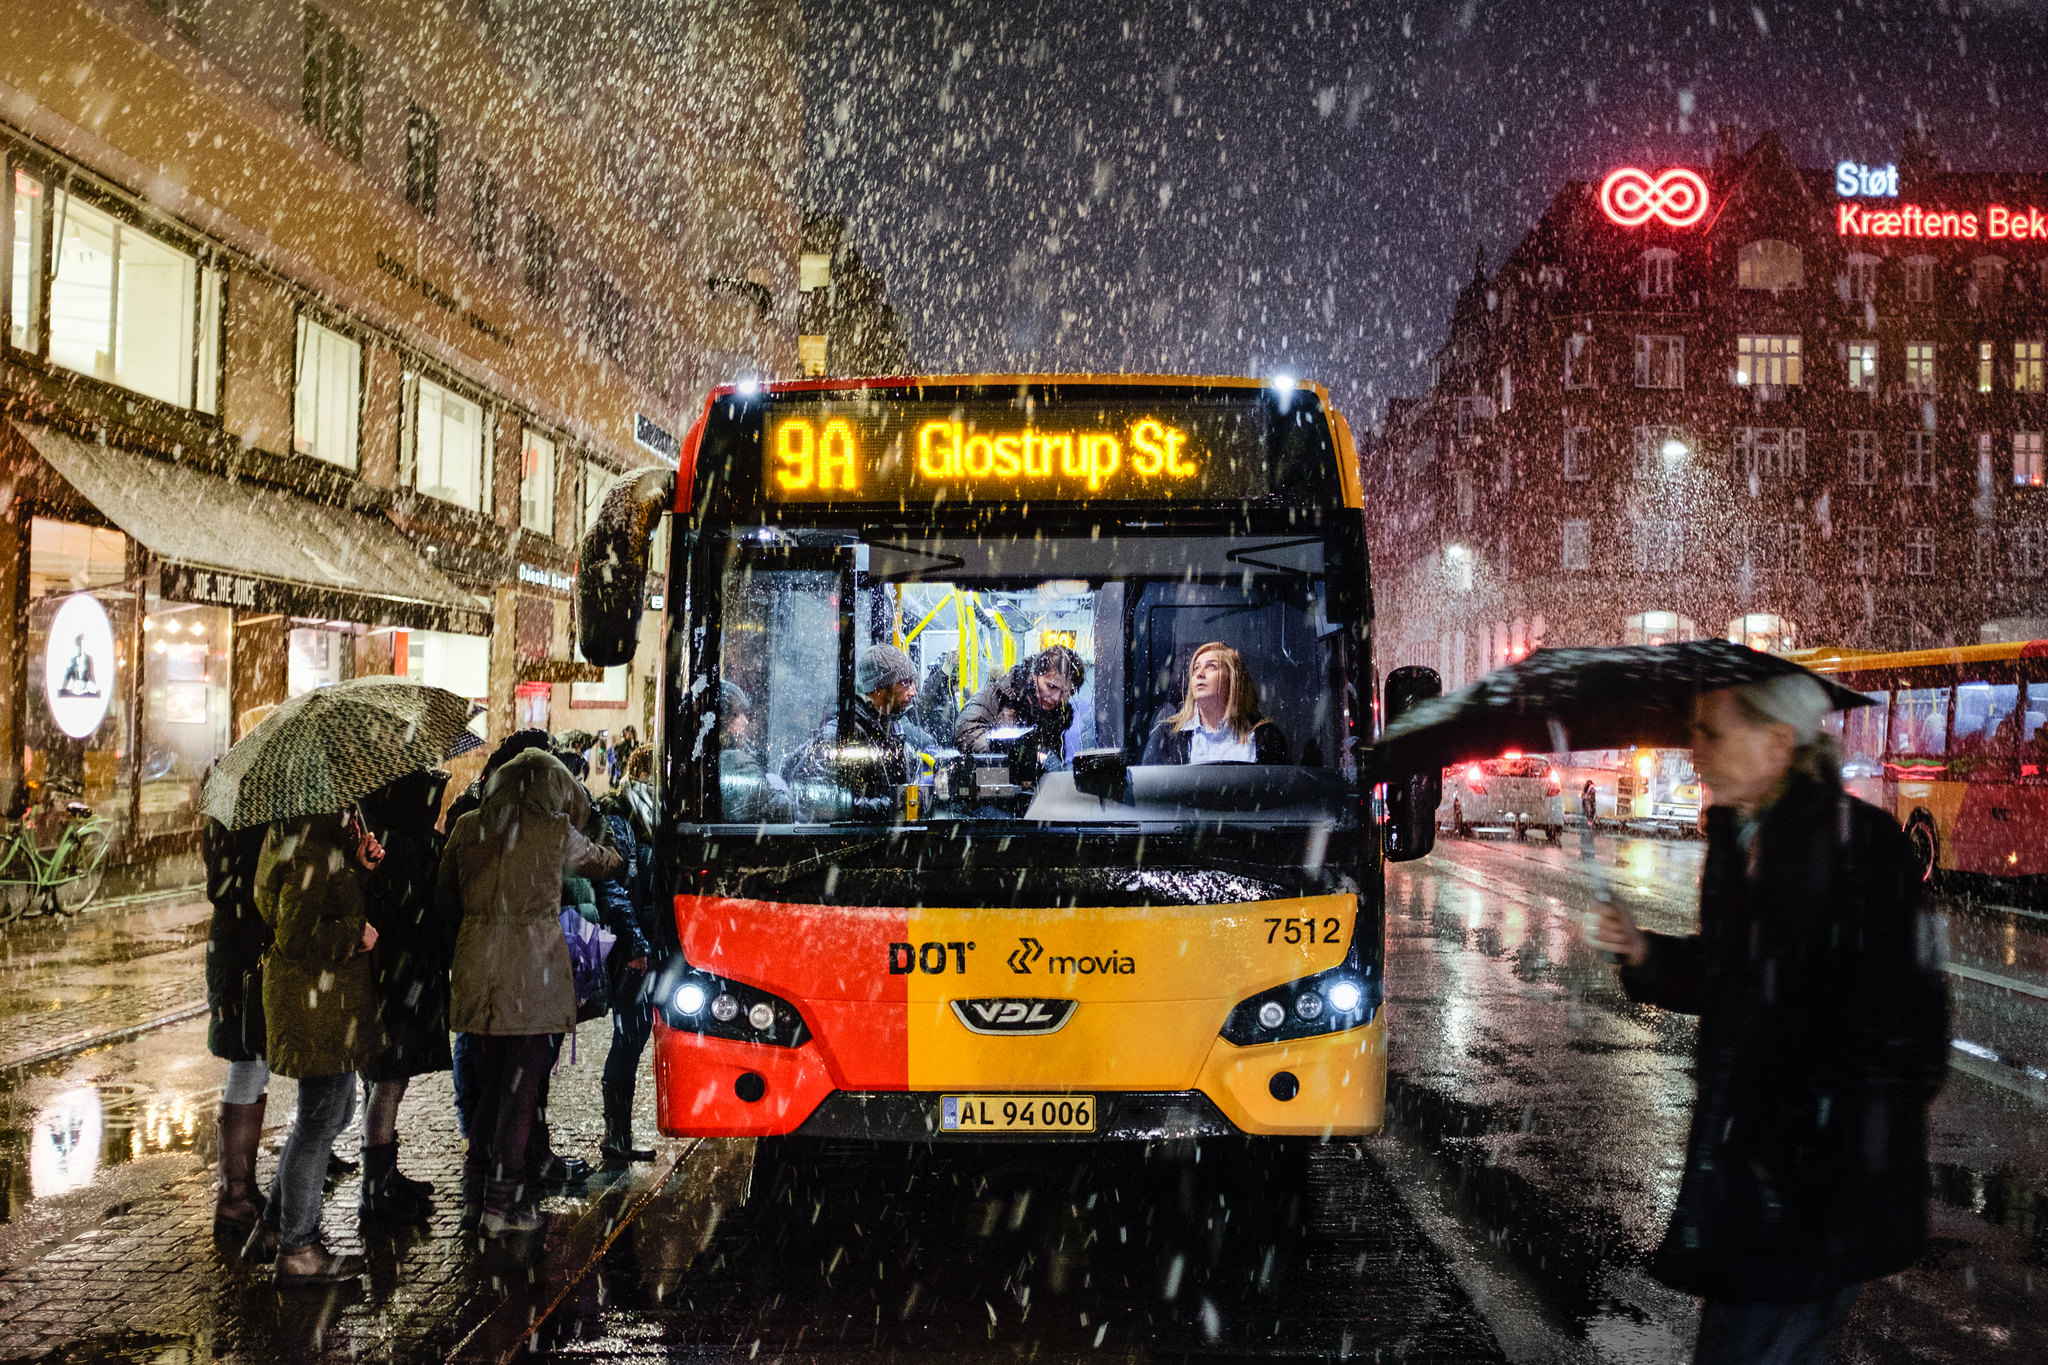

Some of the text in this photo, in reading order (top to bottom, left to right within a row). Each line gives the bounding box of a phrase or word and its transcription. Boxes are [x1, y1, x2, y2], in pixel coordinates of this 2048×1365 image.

[1837, 161, 1899, 197] Støt
[1839, 203, 2048, 240] Kræftens Bek
[776, 419, 1197, 491] 9A Glostrup St.
[519, 563, 551, 586] Danske
[193, 572, 210, 600] JOE
[216, 575, 233, 603] THE
[233, 578, 256, 606] JUICE
[1264, 917, 1341, 944] 7512
[888, 941, 966, 975] DOT
[1048, 950, 1136, 975] movia
[971, 1002, 1054, 1024] VDL
[944, 1115, 956, 1124] DK
[960, 1101, 1090, 1127] AL 94 006
